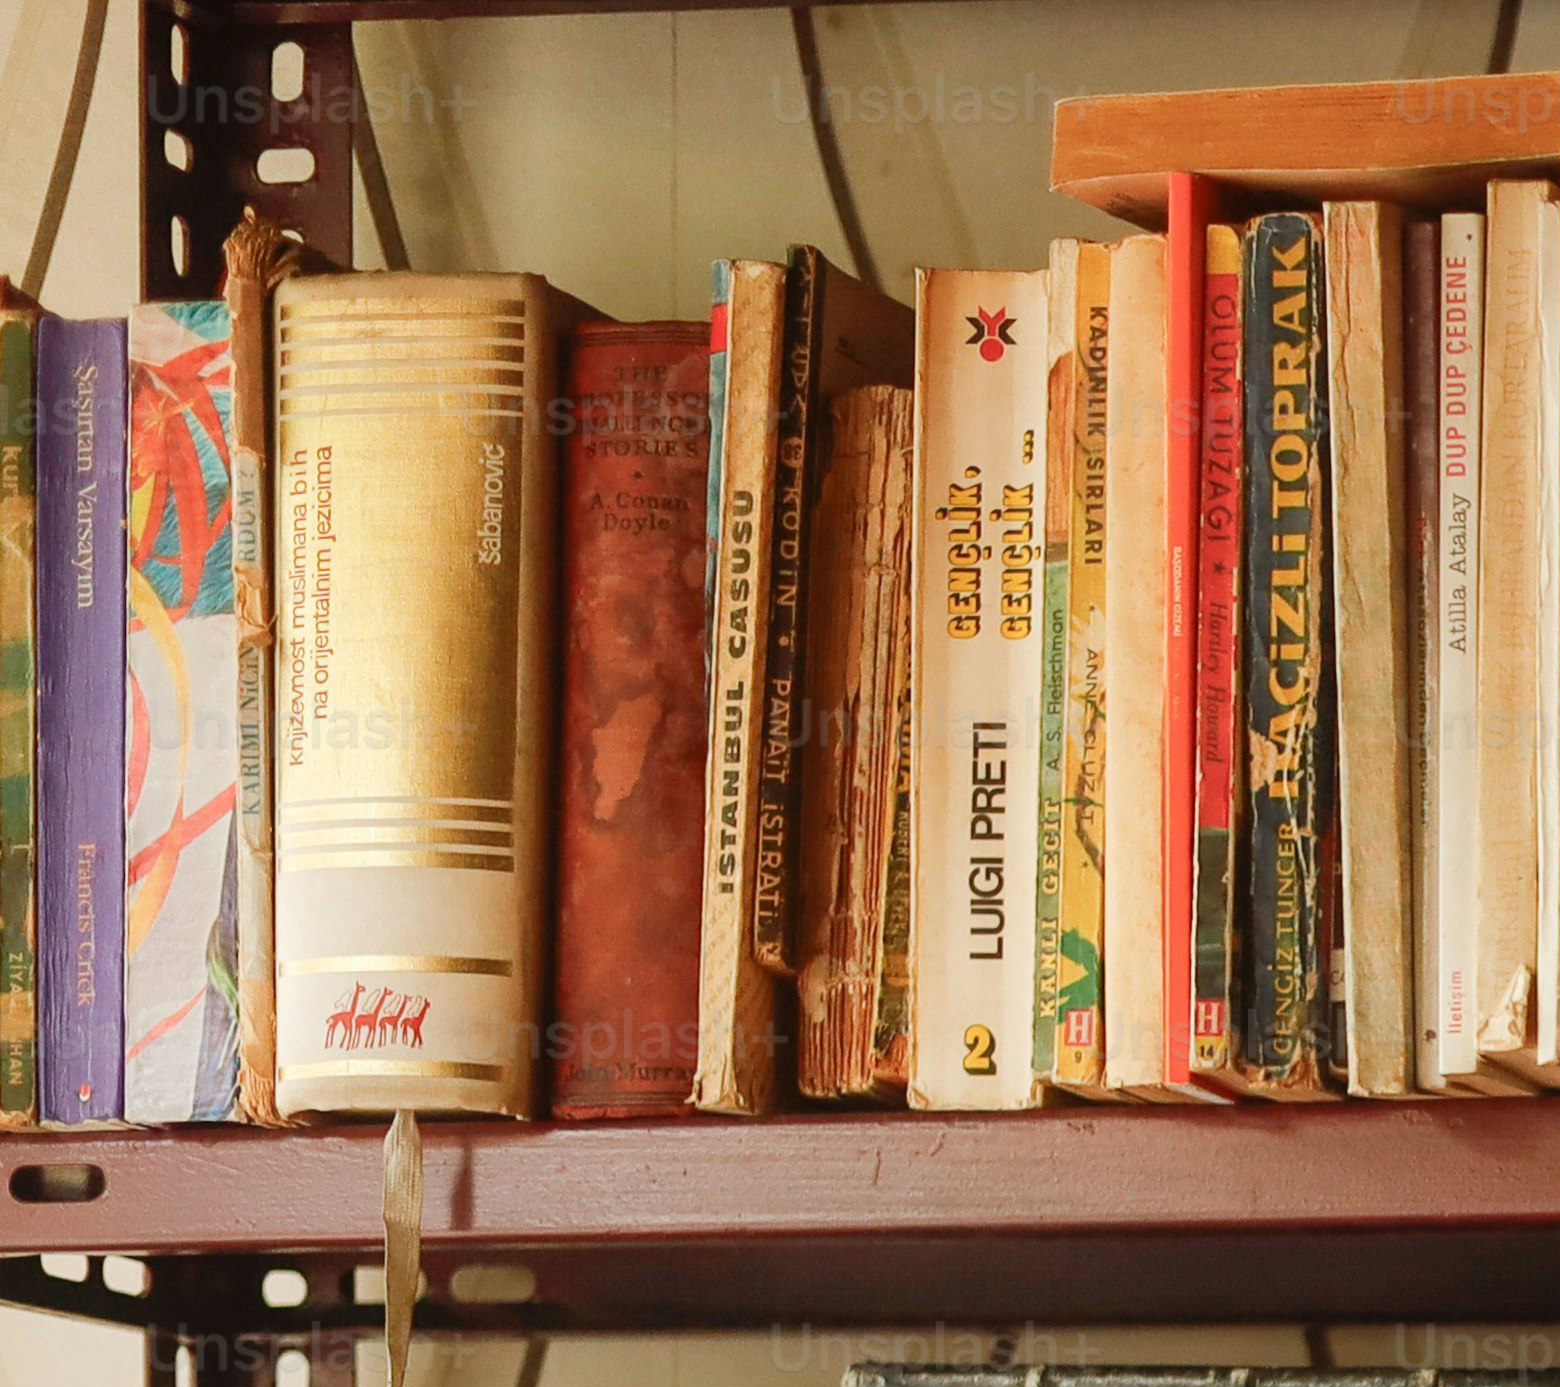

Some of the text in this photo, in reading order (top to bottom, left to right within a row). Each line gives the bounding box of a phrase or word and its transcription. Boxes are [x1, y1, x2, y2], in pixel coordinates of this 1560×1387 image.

[1082, 305, 1107, 566] KADINLIK SIRLARI
[1270, 235, 1311, 516] TOPRAK
[1444, 255, 1472, 654] Atilla Atalay DUP DUP ÇEDENE
[312, 445, 333, 719] na orijentalnim jezicima
[603, 514, 669, 533] Doyle
[617, 493, 689, 512] Conan
[290, 506, 308, 766] književnost muslimana
[76, 843, 95, 1006] Francis Crick
[970, 722, 1006, 961] LUIGI PRETI
[962, 1026, 996, 1075] 2
